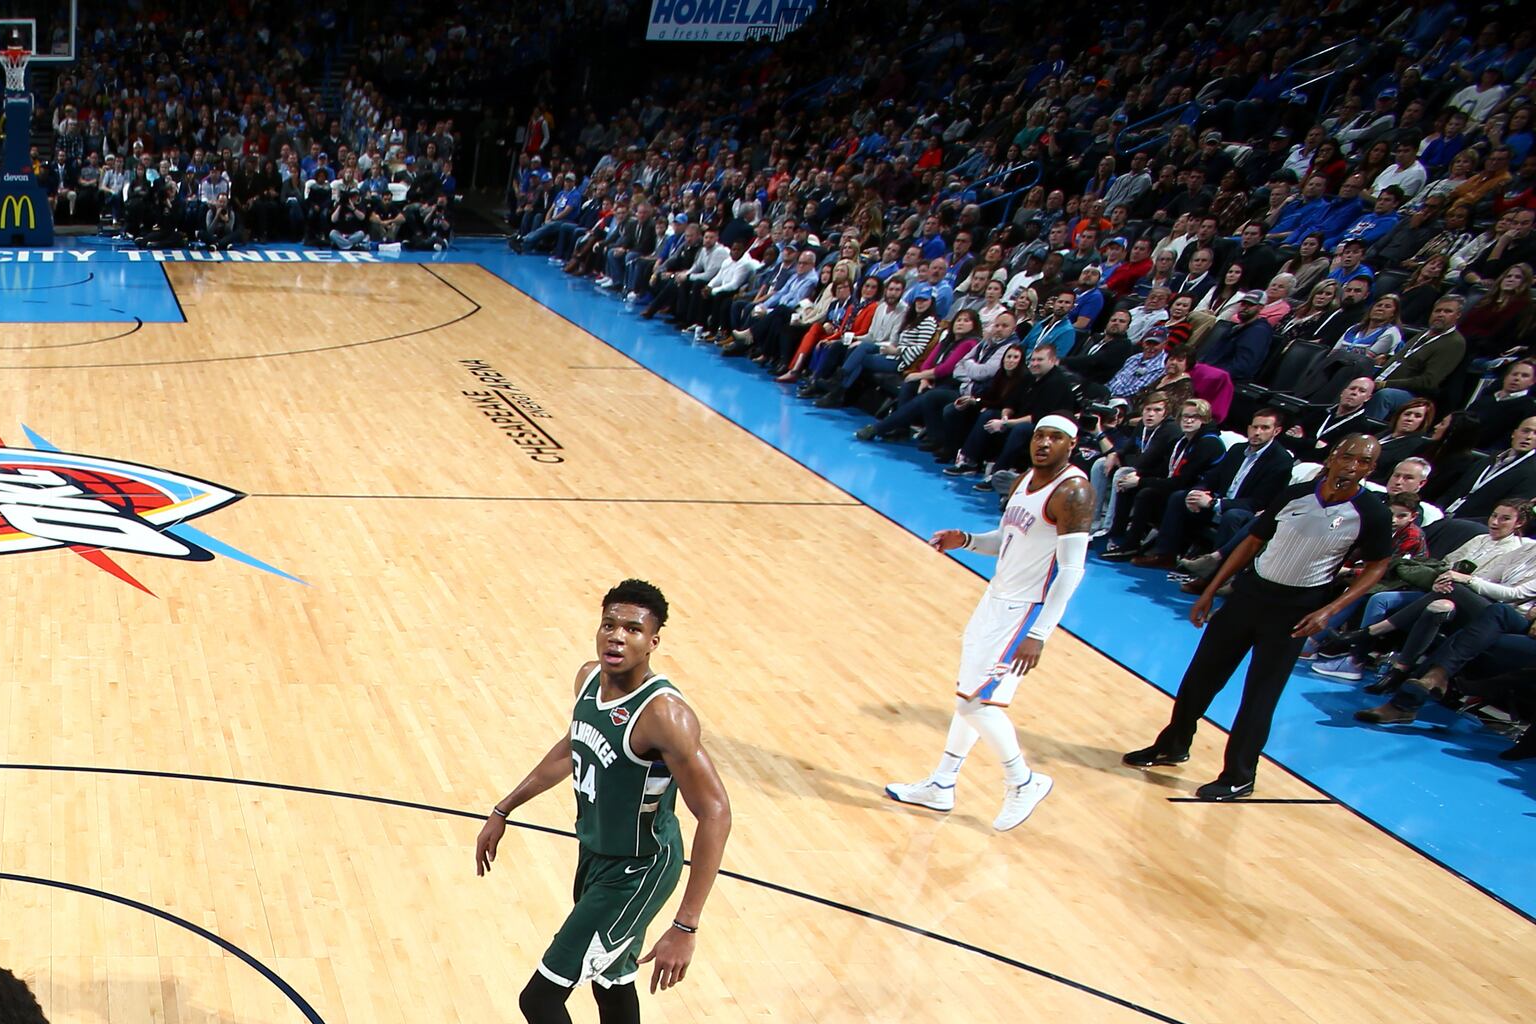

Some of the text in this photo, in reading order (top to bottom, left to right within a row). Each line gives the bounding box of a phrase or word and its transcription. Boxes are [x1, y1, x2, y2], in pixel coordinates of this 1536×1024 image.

[673, 27, 708, 40] fresh
[3, 172, 29, 181] devon
[118, 250, 383, 263] THUNDER
[458, 360, 553, 418] ENERGY ARENA
[462, 391, 565, 464] CHESAPEAKE
[571, 750, 596, 804] 34
